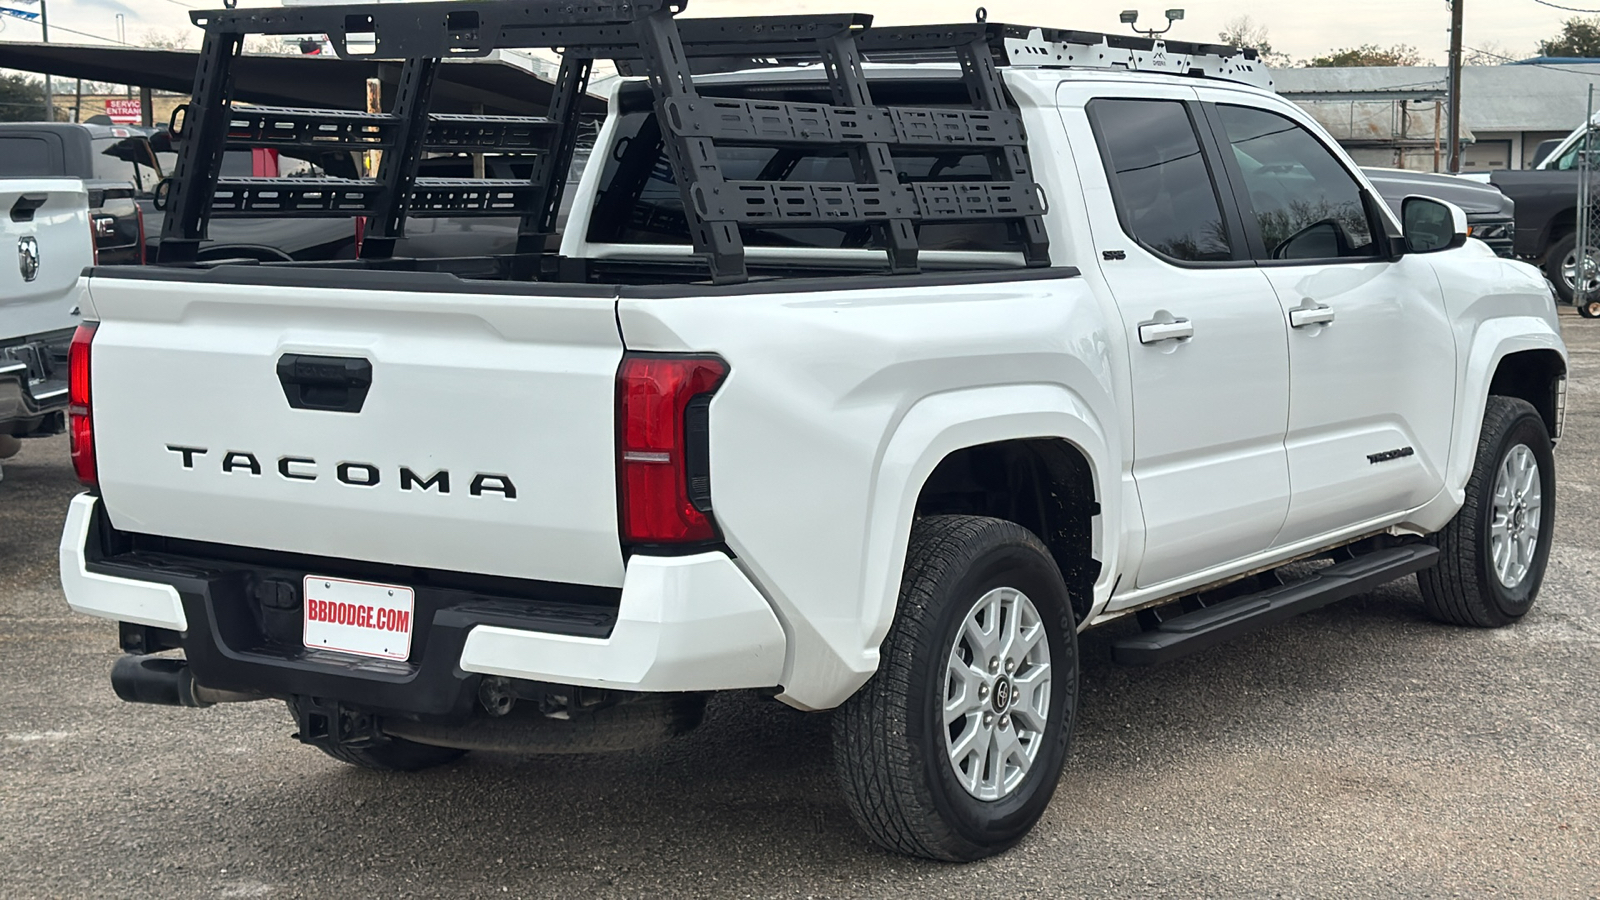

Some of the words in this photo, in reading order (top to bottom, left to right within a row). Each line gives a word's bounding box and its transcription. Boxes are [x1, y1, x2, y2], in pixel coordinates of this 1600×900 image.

[110, 100, 141, 108] SERVIC
[165, 444, 517, 499] TACOMA
[308, 599, 410, 633] BBDODGE.COM
